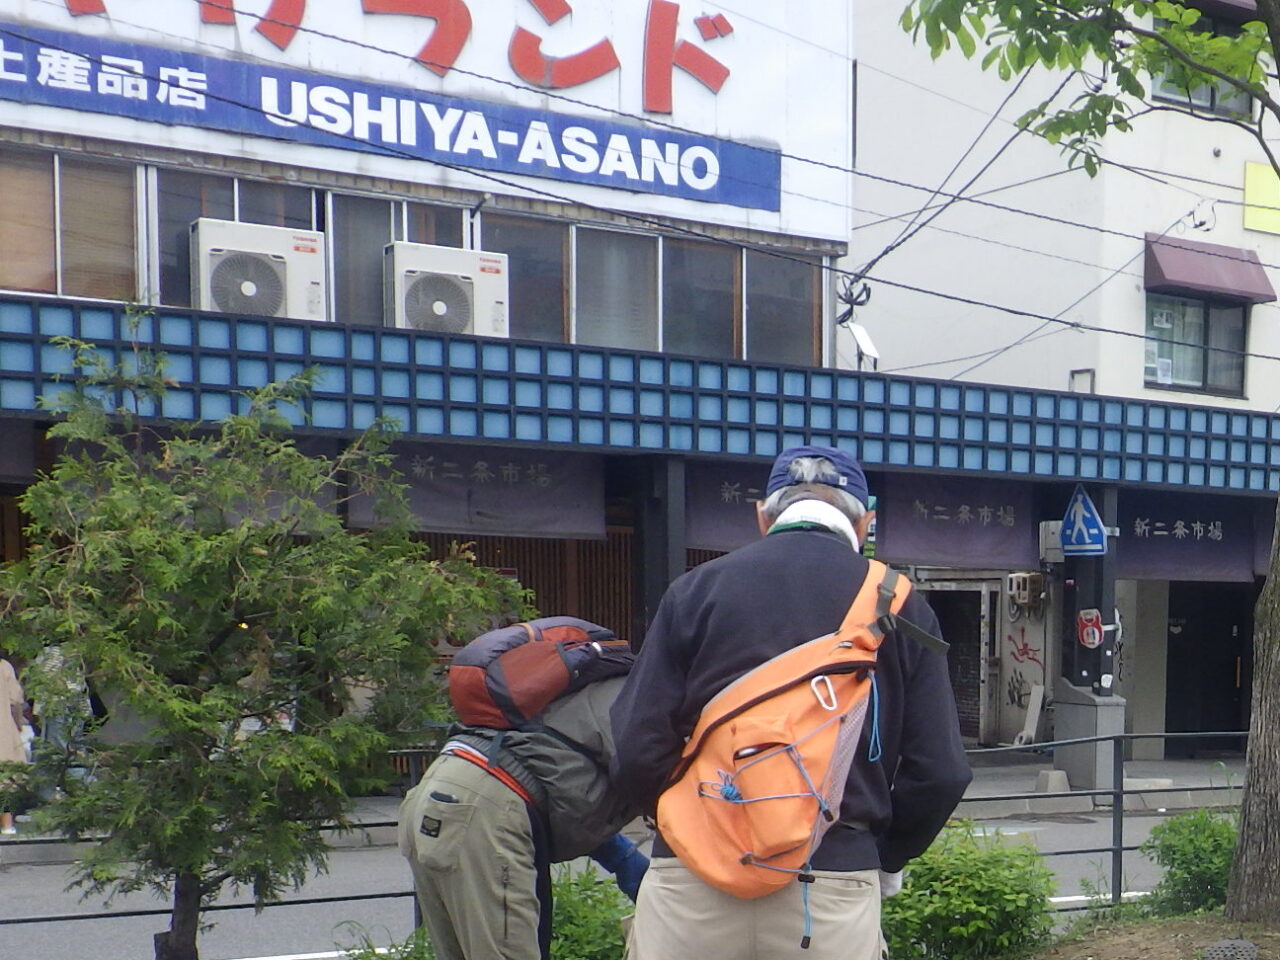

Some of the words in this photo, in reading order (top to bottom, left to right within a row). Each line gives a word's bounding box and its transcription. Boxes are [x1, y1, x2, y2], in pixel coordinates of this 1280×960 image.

[259, 76, 720, 191] USHIYA-ASANO
[411, 454, 552, 488] 新二条市場
[1133, 517, 1224, 541] 新二条市場
